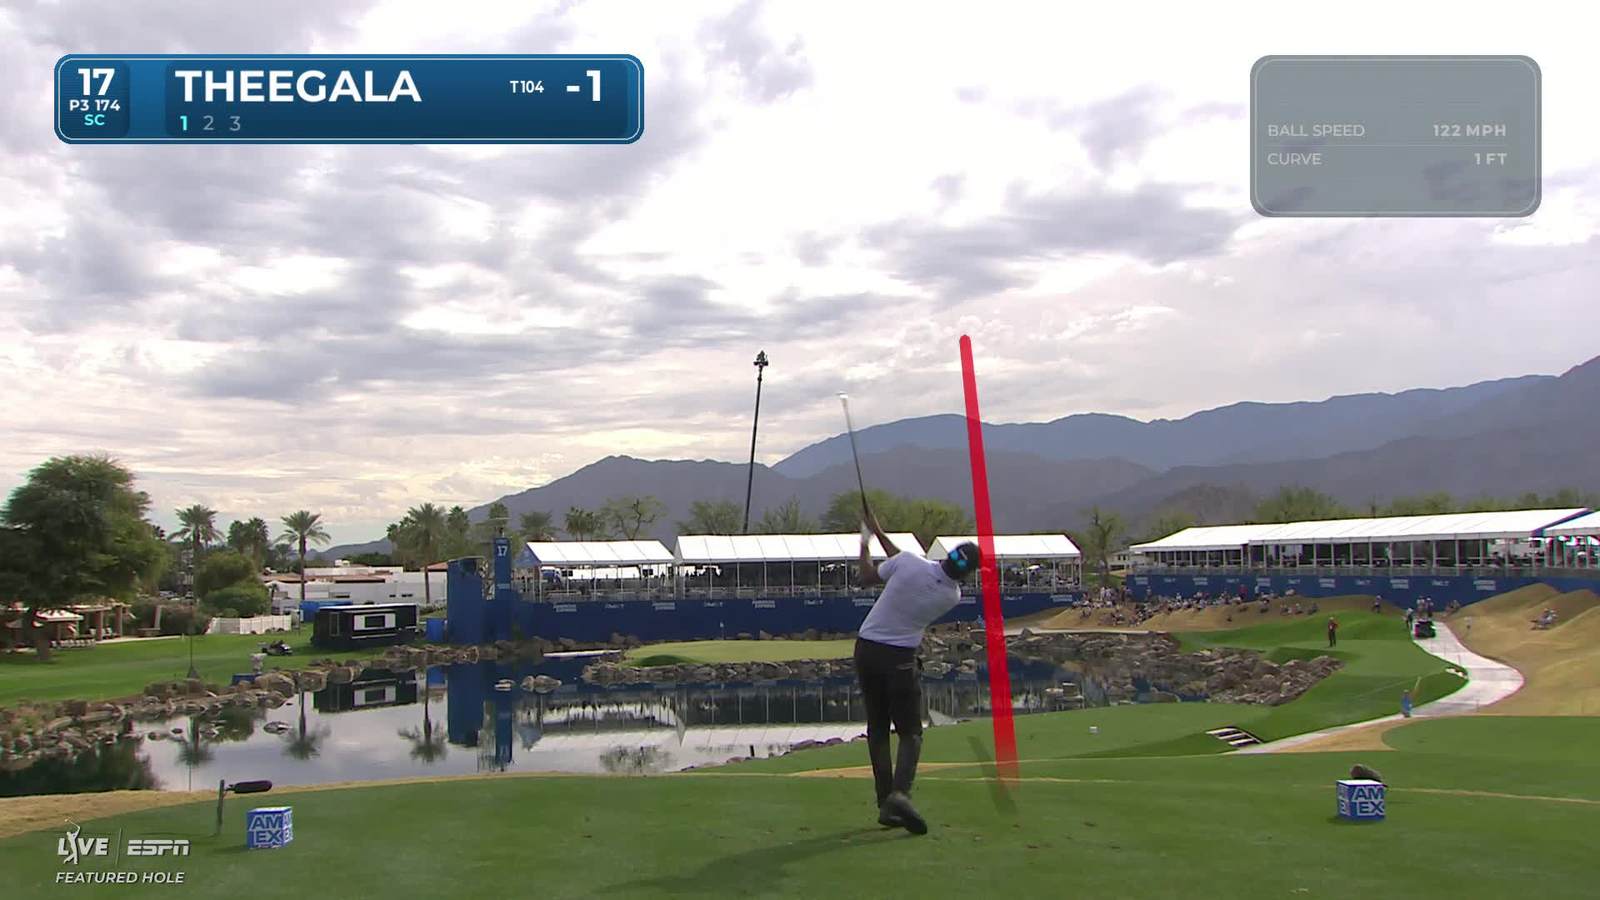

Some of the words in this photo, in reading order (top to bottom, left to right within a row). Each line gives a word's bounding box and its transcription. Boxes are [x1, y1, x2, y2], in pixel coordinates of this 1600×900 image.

[497, 545, 508, 557] 17
[249, 814, 282, 831] AM
[254, 830, 282, 845] EX
